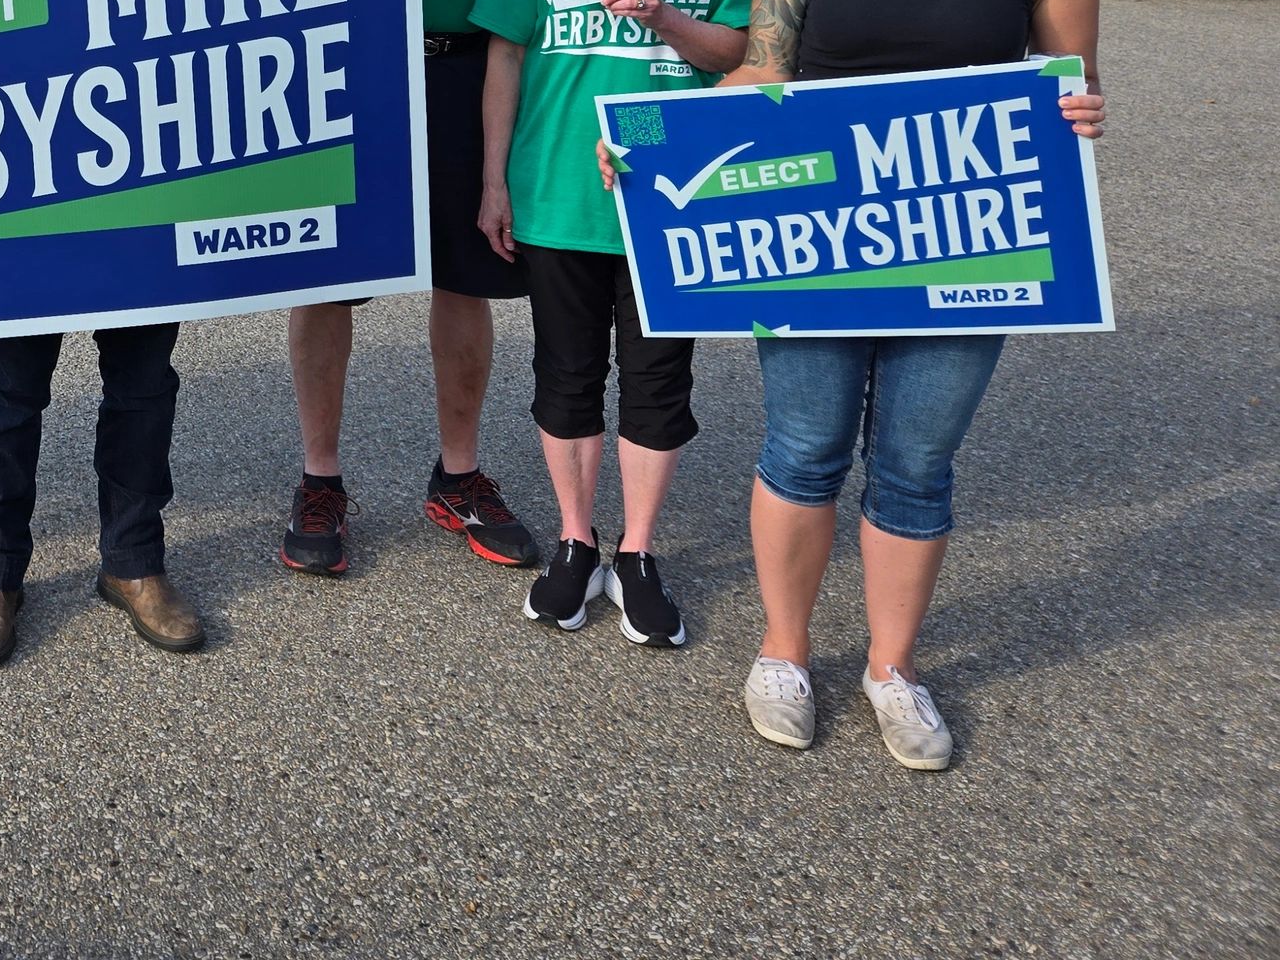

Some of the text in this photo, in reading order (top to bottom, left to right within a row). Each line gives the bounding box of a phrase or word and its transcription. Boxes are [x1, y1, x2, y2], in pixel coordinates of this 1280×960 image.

[849, 96, 1040, 196] MIKE
[719, 158, 819, 192] ELECT
[192, 217, 320, 256] WARD 2
[662, 180, 1051, 288] DERBYSHIRE
[939, 287, 1030, 304] WARD 2
